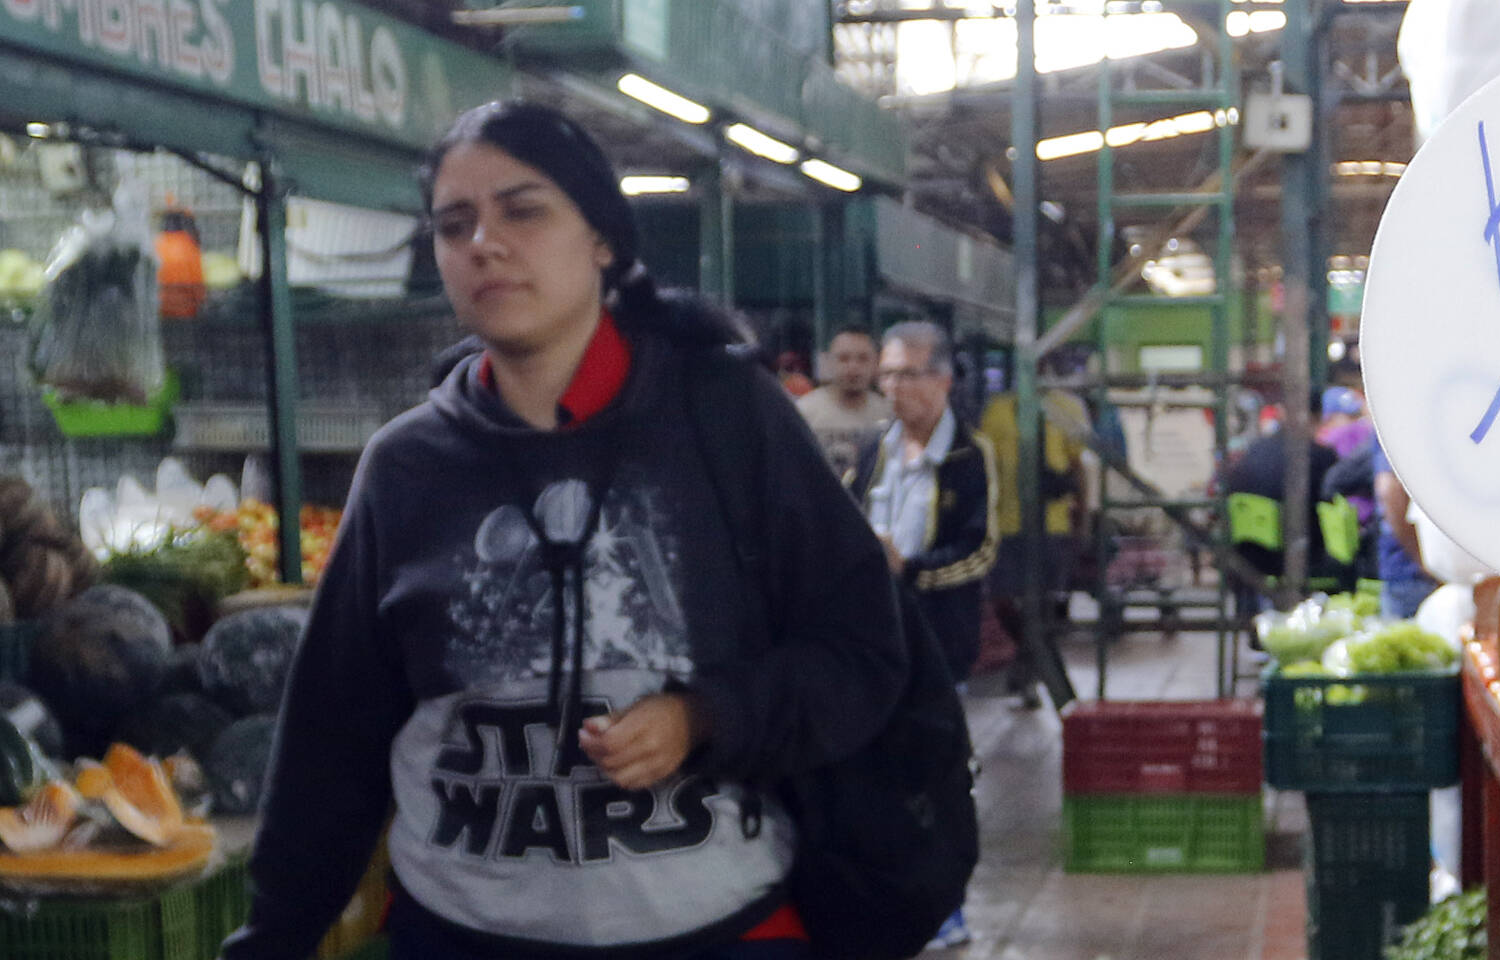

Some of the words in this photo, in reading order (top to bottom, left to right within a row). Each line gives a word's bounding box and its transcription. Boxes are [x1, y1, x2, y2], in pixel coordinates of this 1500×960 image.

[5, 0, 233, 82] BRES
[255, 0, 406, 125] CHALO
[434, 700, 618, 777] STA
[430, 776, 715, 864] WARS
